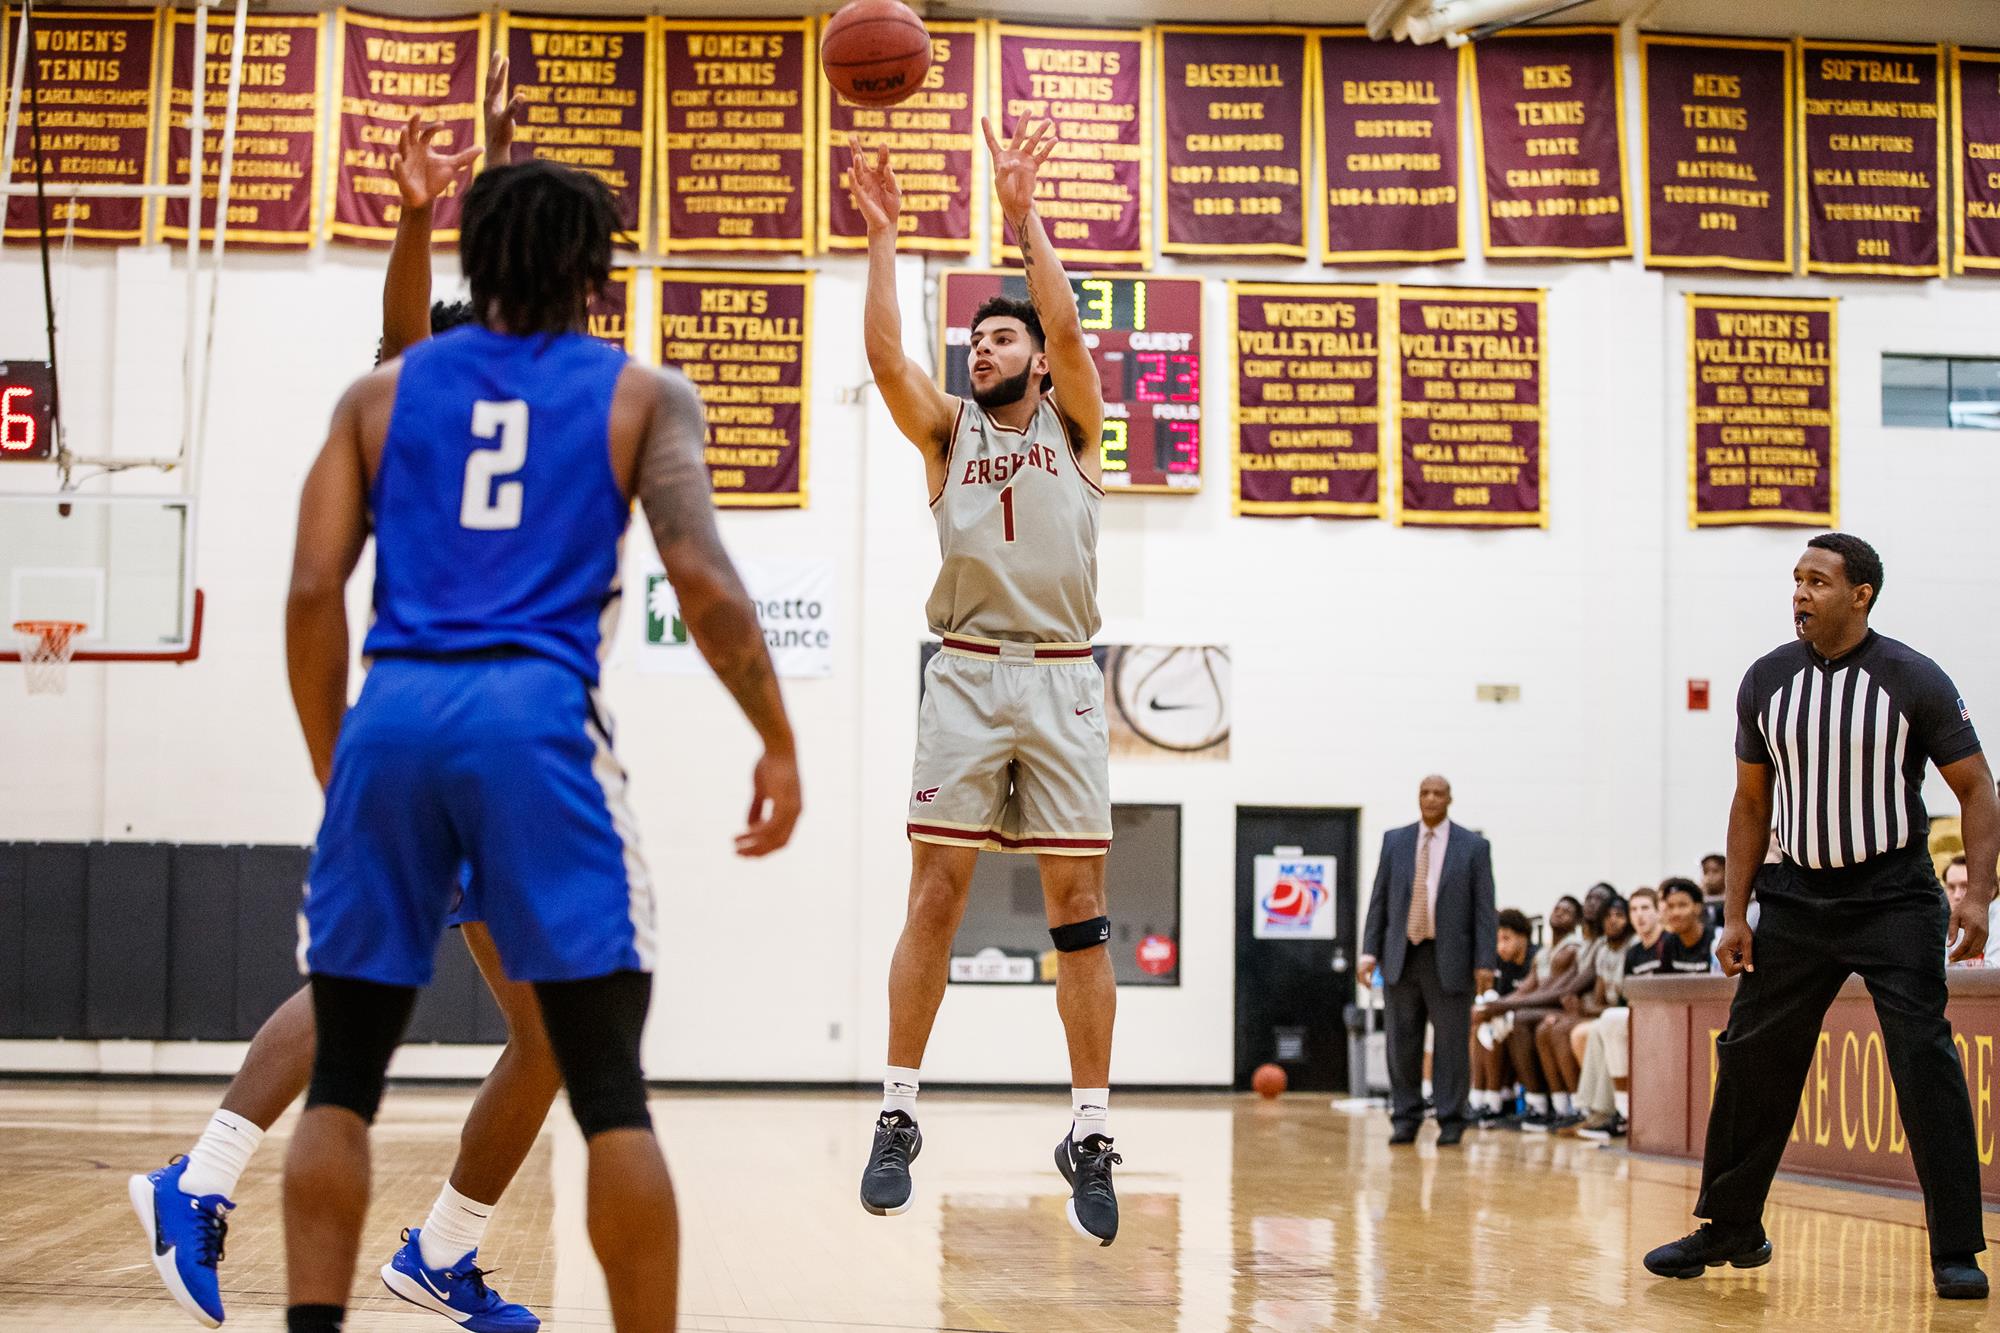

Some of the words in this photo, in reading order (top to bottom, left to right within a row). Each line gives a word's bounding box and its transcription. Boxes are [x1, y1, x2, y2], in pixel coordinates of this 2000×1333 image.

[35, 29, 127, 52] WOMEN'S
[366, 37, 456, 65] WOMEN'S
[531, 33, 624, 58] WOMEN'S
[686, 35, 784, 58] WOMEN'S
[39, 59, 120, 82] TENNIS
[1023, 47, 1120, 75] WOMEN'S
[1821, 58, 1920, 84] SOFTBALL
[536, 60, 617, 85] TENNIS
[694, 62, 776, 85] TENNIS
[853, 73, 905, 91] NCAA
[1185, 63, 1284, 87] BASEBALL
[368, 71, 451, 97] TENNIS
[1030, 74, 1113, 101] TENNIS
[1343, 80, 1440, 105] BASEBALL
[554, 86, 636, 106] CAROLINAS
[714, 90, 798, 107] CAROLINAS
[1050, 101, 1135, 121] CAROLINAS
[1208, 102, 1264, 120] STATE
[1514, 101, 1585, 126] TENNIS
[1681, 105, 1748, 131] TENNIS
[1354, 119, 1433, 138] DISTRICT
[1186, 134, 1284, 151] CHAMPIONS
[1525, 137, 1580, 157] STATE
[1696, 136, 1737, 154] NAIA
[1829, 134, 1913, 153] CHAMPIONS
[60, 157, 138, 175] REGIONAL
[690, 154, 781, 171] CHAMPIONS
[1346, 153, 1441, 172] CHAMPIONS
[1677, 161, 1757, 182] NATIONAL
[677, 175, 719, 192] NCAA
[1506, 168, 1600, 187] CHAMPIONS
[1813, 169, 1854, 186] NCAA
[1858, 170, 1930, 188] REGIONAL
[684, 196, 789, 214] TOURNAMENT
[1663, 185, 1770, 208] TOURNAMENT
[1824, 204, 1920, 223] TOURNAMENT
[700, 289, 768, 314] MEN'S
[1263, 302, 1356, 328] WOMEN'S
[1422, 305, 1518, 331] WOMEN'S
[663, 314, 803, 342] VOLLEYBALL
[1716, 313, 1810, 339] WOMEN'S
[1129, 332, 1193, 351] GUEST
[1239, 331, 1378, 357] VOLLEYBALL
[1401, 334, 1538, 361] VOLLEYBALL
[1696, 339, 1829, 365] VOLLEYBALL
[709, 343, 798, 363] CAROLINAS
[1136, 353, 1199, 402] 23
[1288, 361, 1373, 379] CAROLINAS
[1450, 361, 1532, 380] CAROLINAS
[1743, 366, 1825, 385] CAROLINAS
[0, 386, 35, 450] 6
[1269, 430, 1353, 448] CHAMPIONS
[1429, 423, 1513, 442] CHAMPIONS
[1720, 426, 1805, 445] CHAMPIONS
[1101, 420, 1127, 470] 2
[1168, 422, 1199, 472] 3
[1412, 444, 1454, 462] NCAA
[460, 399, 529, 530] 2
[1706, 447, 1746, 465] NCAA
[1421, 465, 1520, 485] TOURNAMENT
[1750, 467, 1818, 487] FINALIST
[1000, 486, 1016, 543] 1
